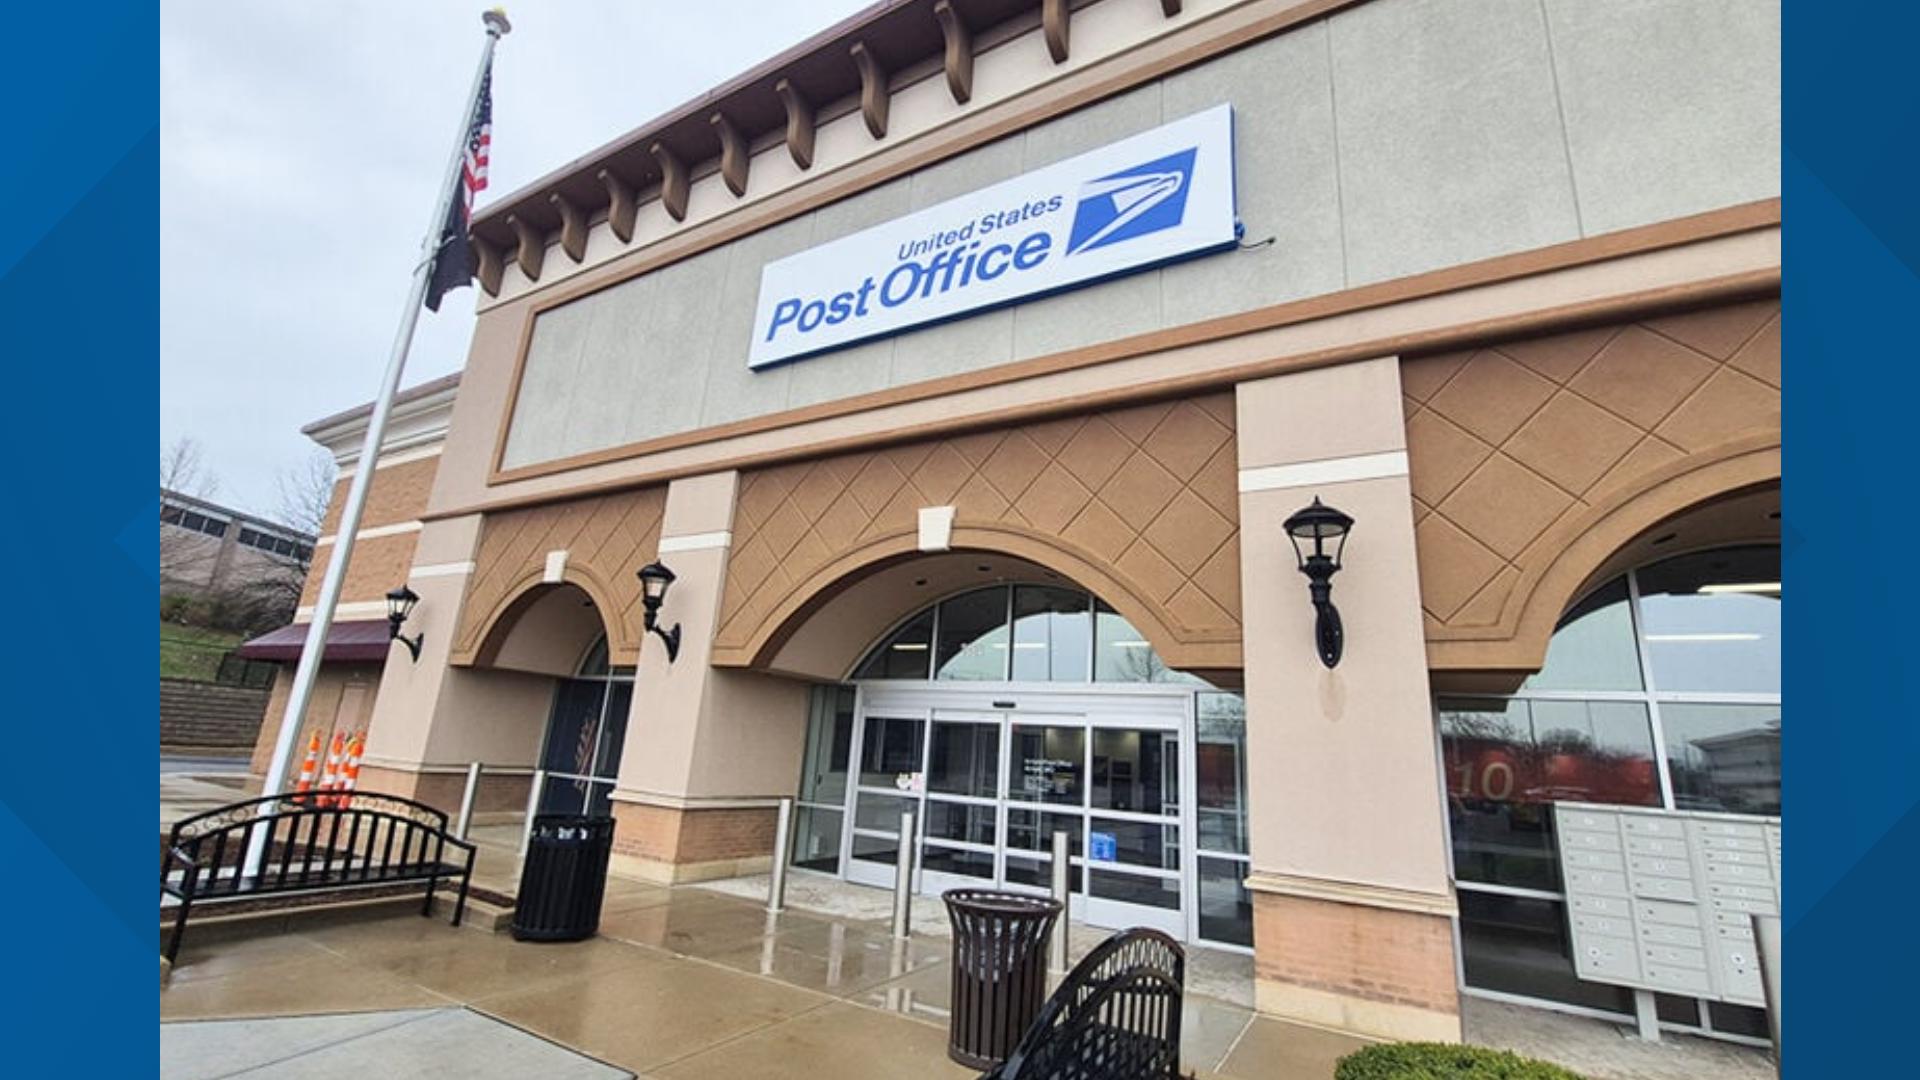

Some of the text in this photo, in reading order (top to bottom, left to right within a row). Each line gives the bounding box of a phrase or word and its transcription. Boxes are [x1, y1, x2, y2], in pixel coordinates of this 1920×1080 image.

[898, 195, 1063, 261] United States
[767, 232, 1053, 342] Post Office
